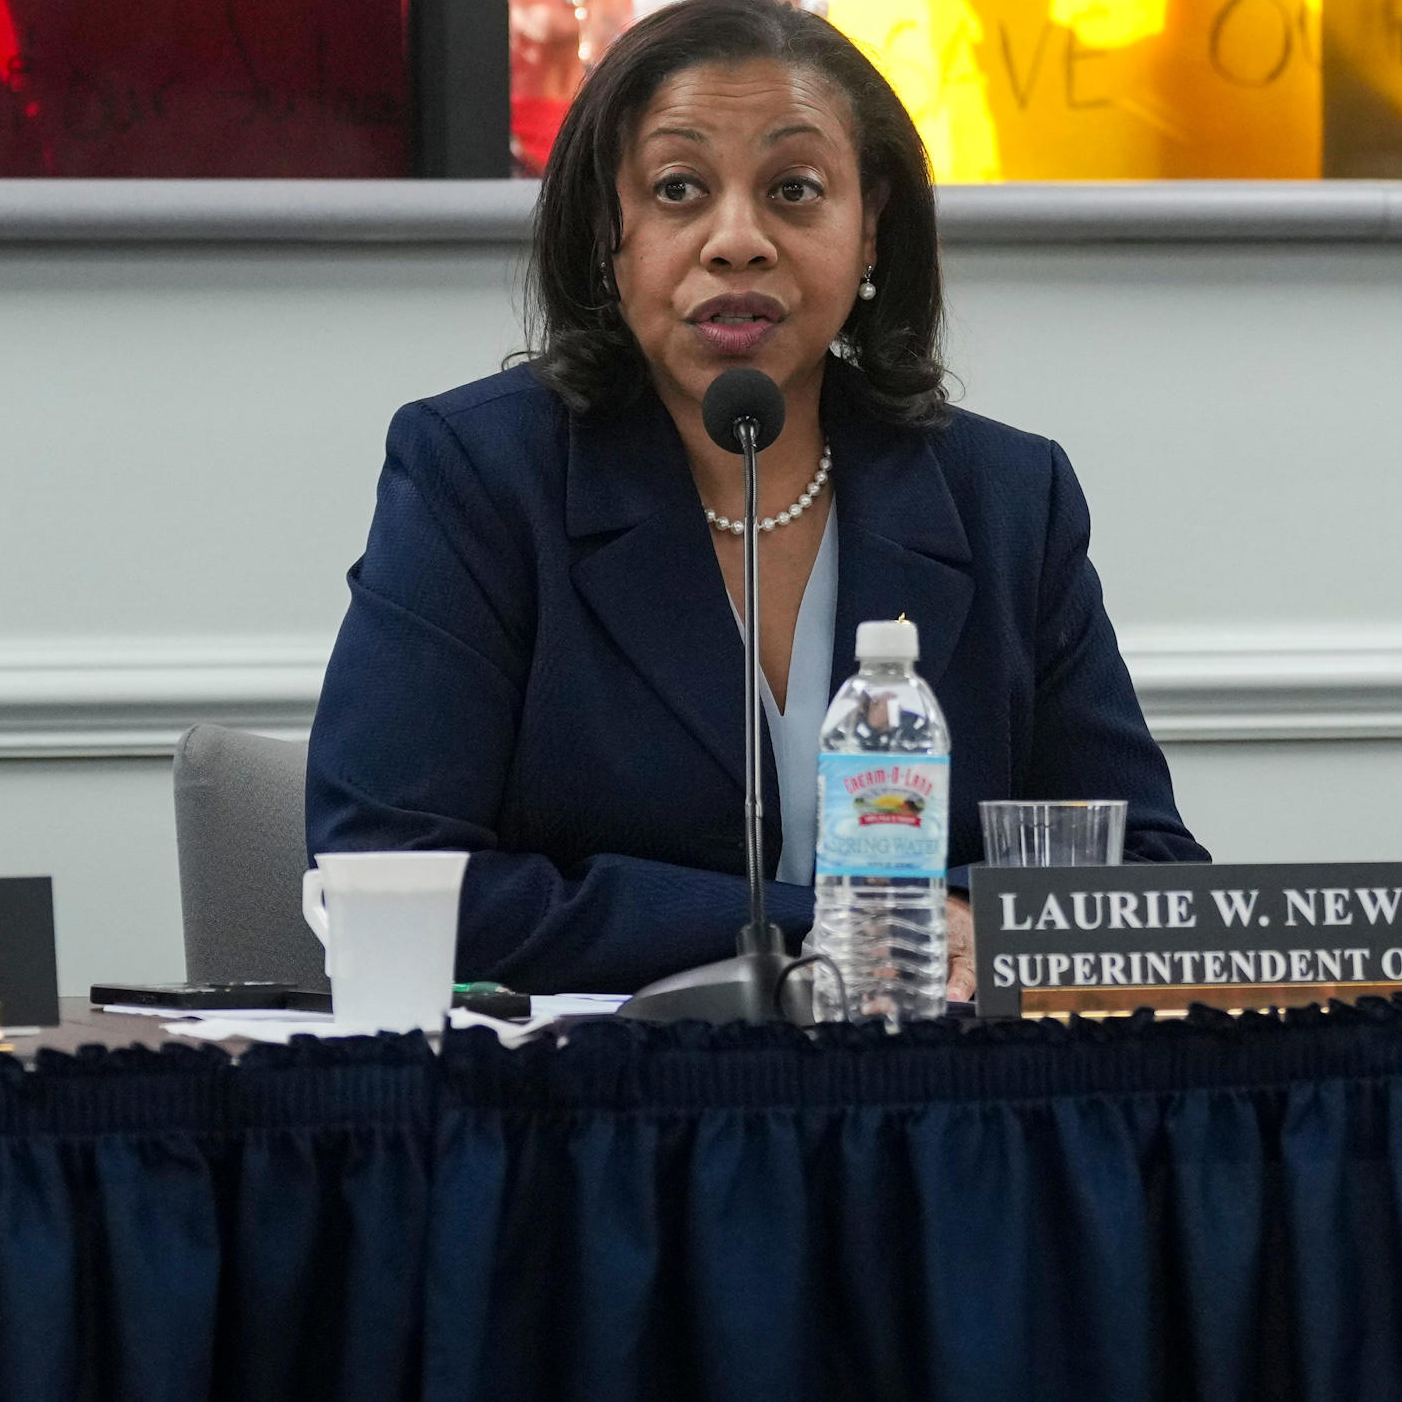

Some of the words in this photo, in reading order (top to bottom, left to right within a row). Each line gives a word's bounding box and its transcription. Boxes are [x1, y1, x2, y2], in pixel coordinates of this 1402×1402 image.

[999, 889, 1197, 931] LAURIE
[1211, 889, 1271, 928] W.
[993, 948, 1371, 988] SUPERINTENDENT
